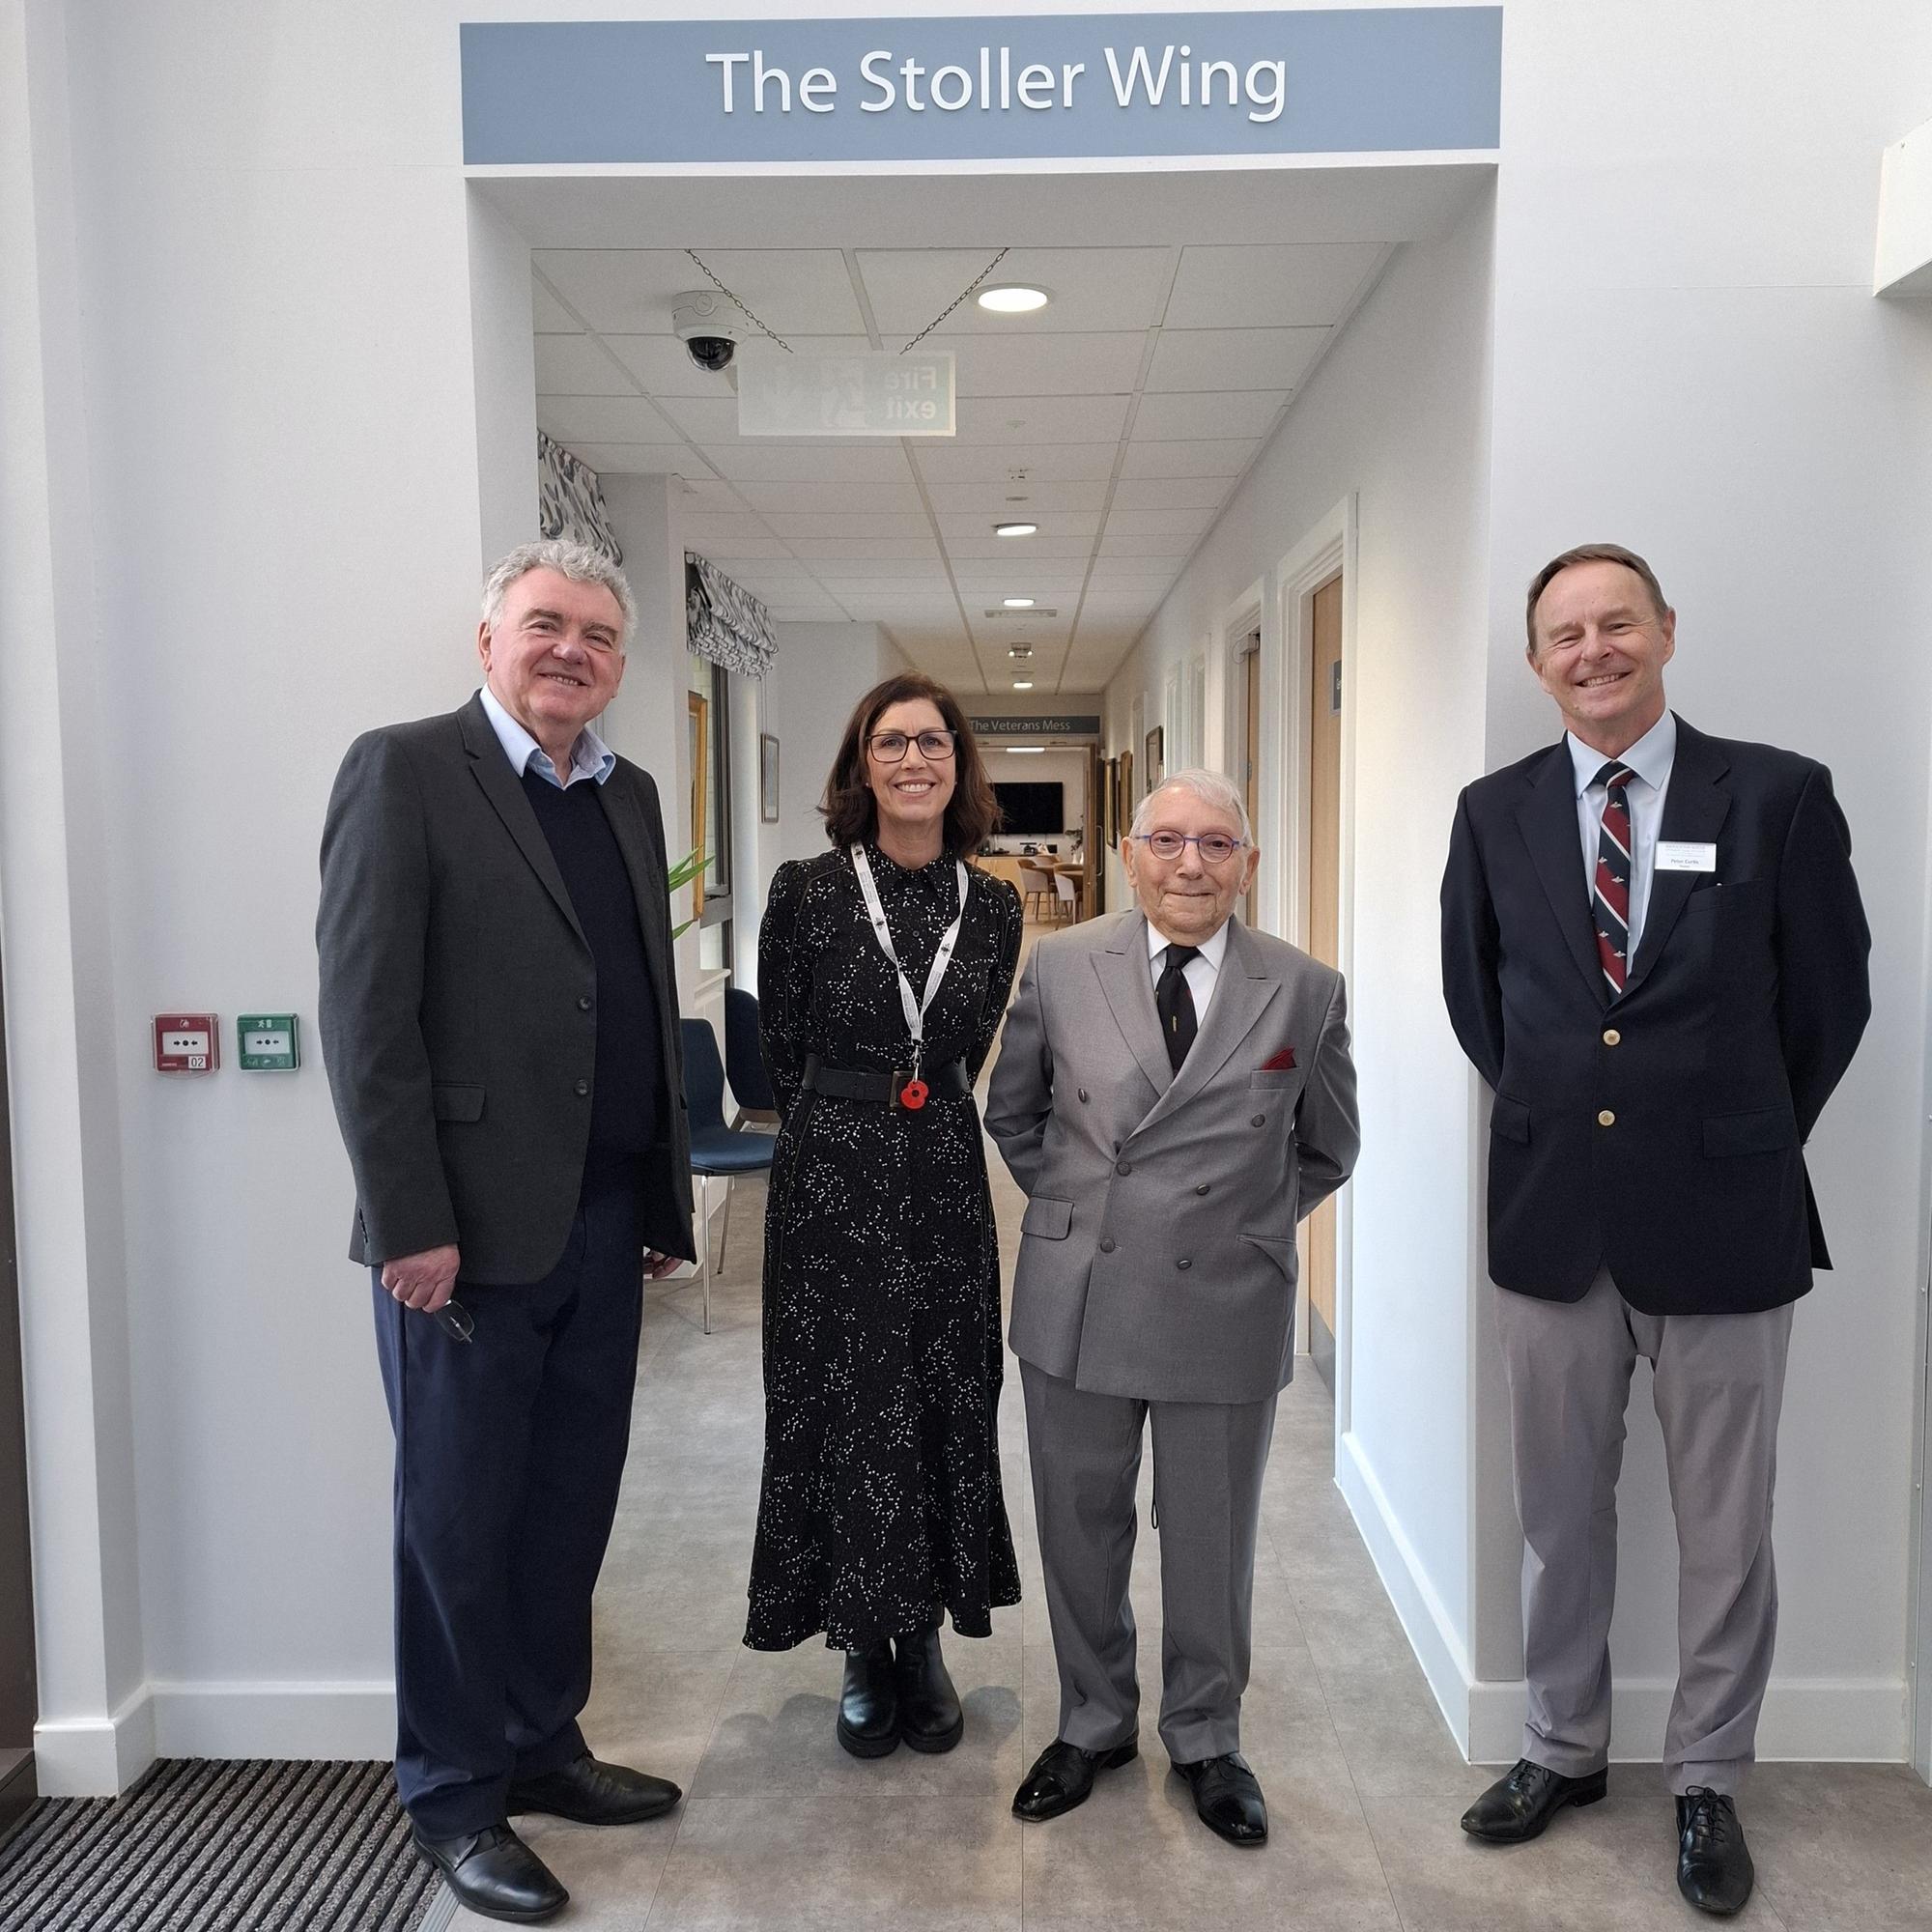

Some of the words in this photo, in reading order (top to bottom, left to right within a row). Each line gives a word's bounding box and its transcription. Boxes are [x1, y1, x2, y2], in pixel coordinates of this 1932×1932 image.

[705, 50, 838, 113] The
[861, 47, 1086, 112] Stoller
[1103, 45, 1288, 124] Wing
[970, 720, 989, 731] The
[991, 720, 1040, 731] Veterans
[1042, 720, 1070, 730] Mess
[191, 1058, 204, 1067] 02
